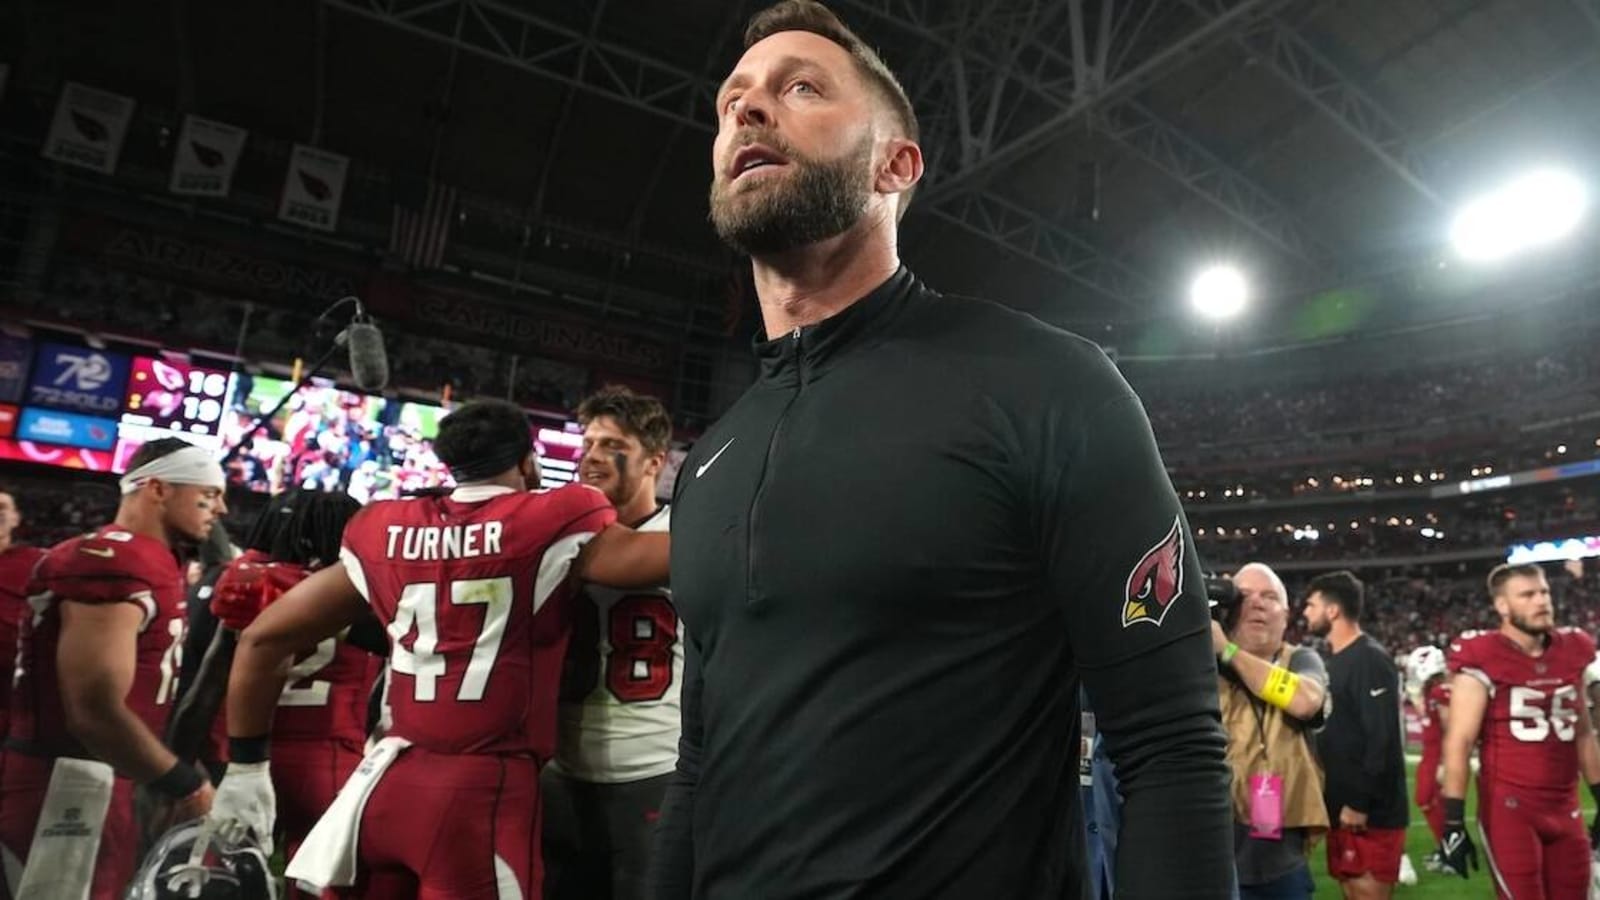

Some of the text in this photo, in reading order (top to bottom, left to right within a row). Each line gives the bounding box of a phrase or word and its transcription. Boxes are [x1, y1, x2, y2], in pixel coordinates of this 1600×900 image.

[105, 227, 353, 299] ARIZONA
[416, 298, 665, 368] CARDINALS
[188, 370, 226, 397] 16
[386, 520, 503, 561] TURNER
[386, 576, 514, 701] 47
[1509, 685, 1578, 742] 56
